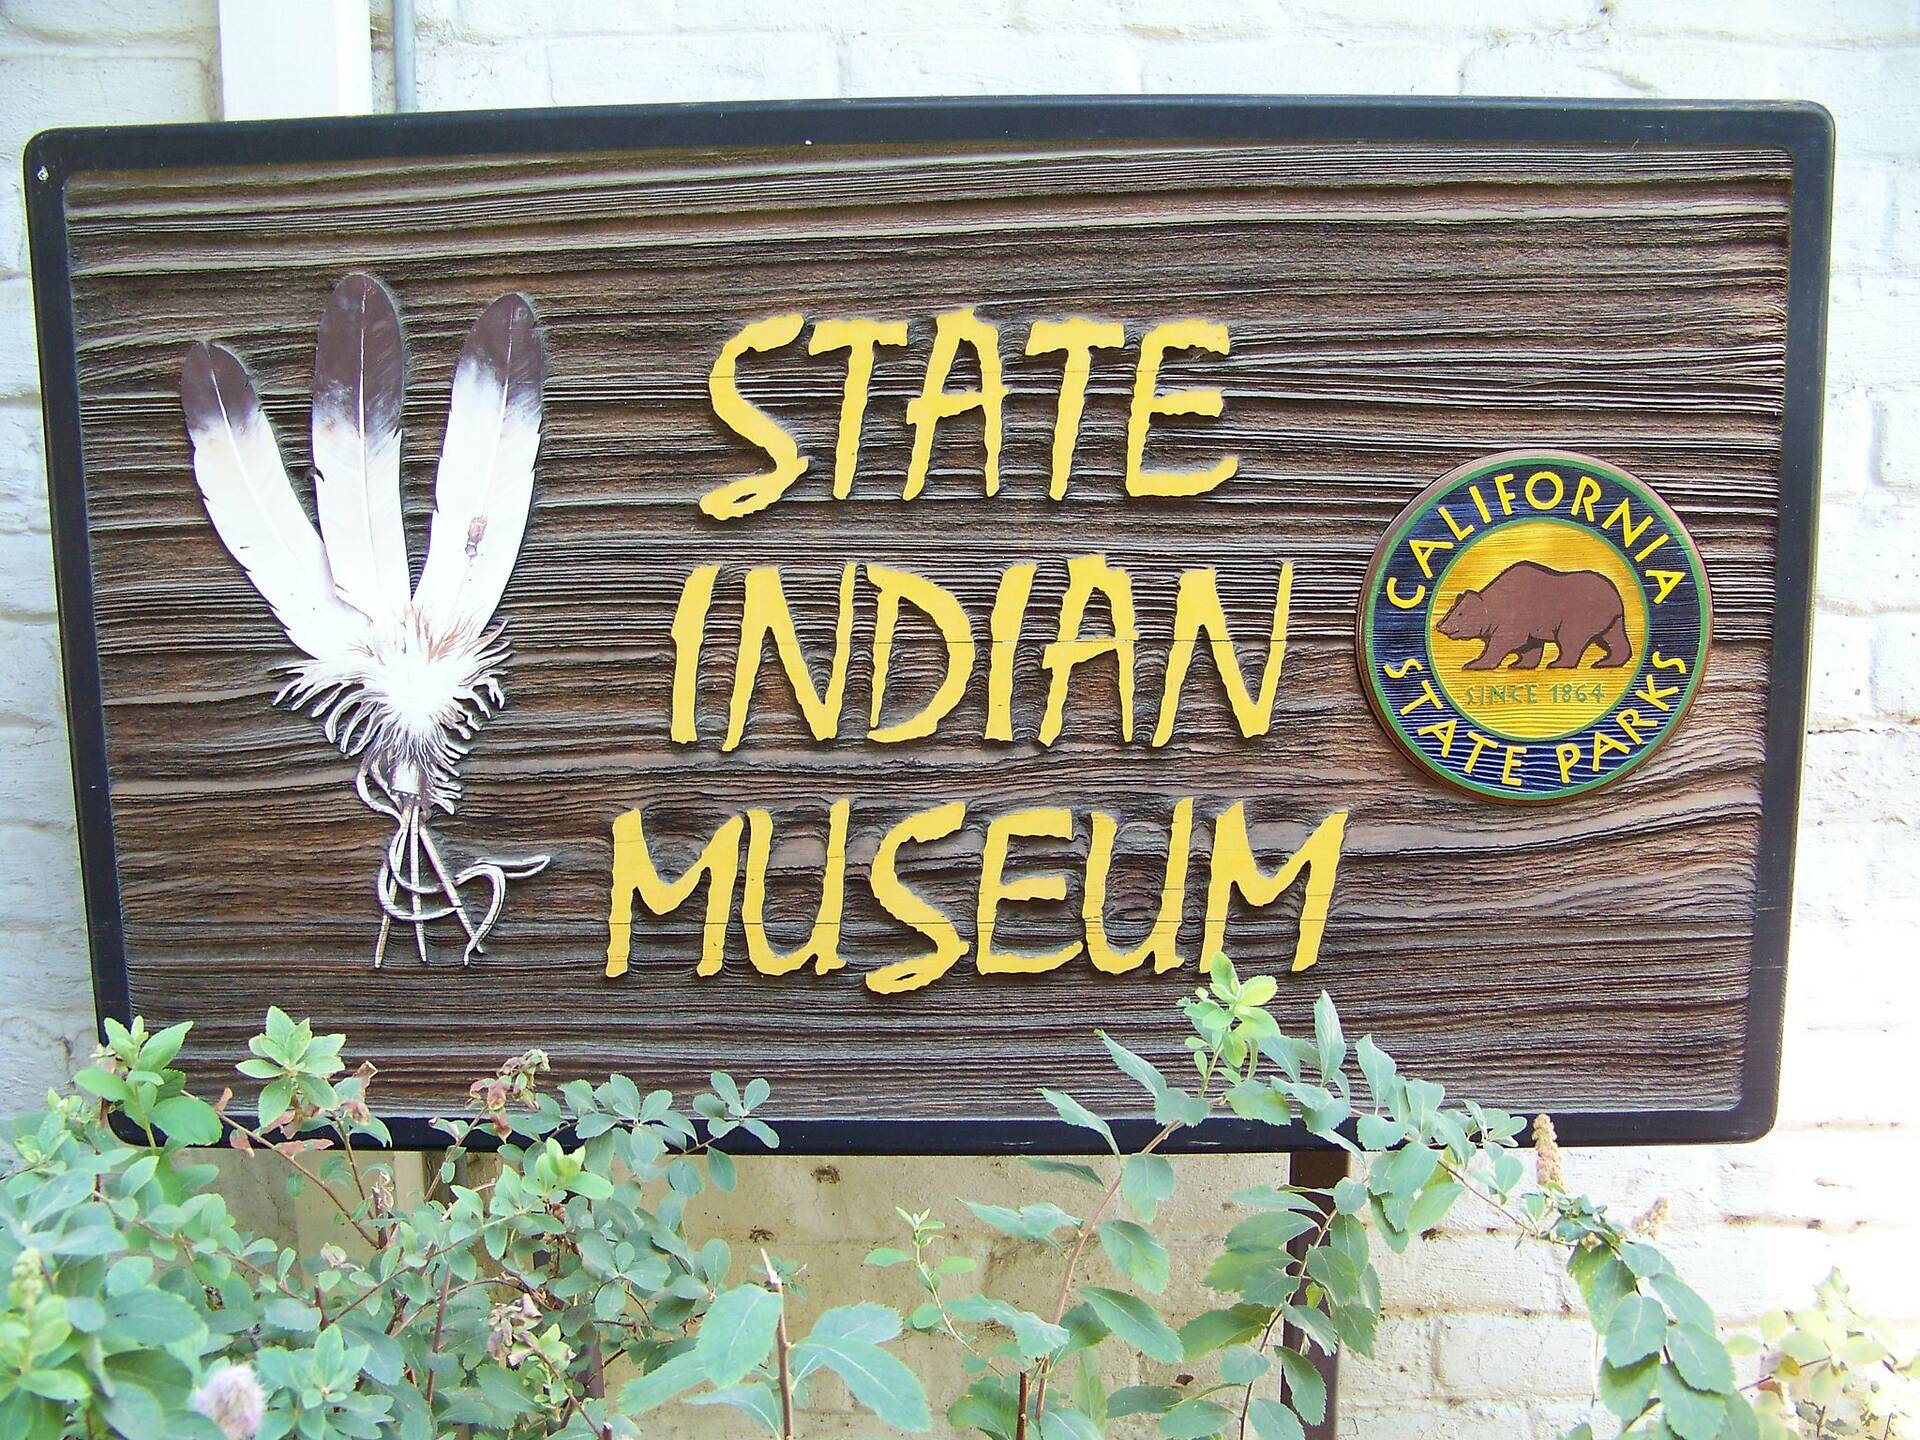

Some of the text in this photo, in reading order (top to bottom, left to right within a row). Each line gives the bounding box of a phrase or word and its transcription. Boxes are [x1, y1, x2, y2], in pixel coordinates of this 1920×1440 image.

[699, 306, 1239, 520] STATE
[1386, 470, 1686, 610] CALIFORNIA
[669, 553, 1294, 752] INDIAN
[1383, 650, 1687, 787] STATE PARKS
[1466, 682, 1605, 706] SINCE 1864
[605, 796, 1349, 995] MUSEUM
